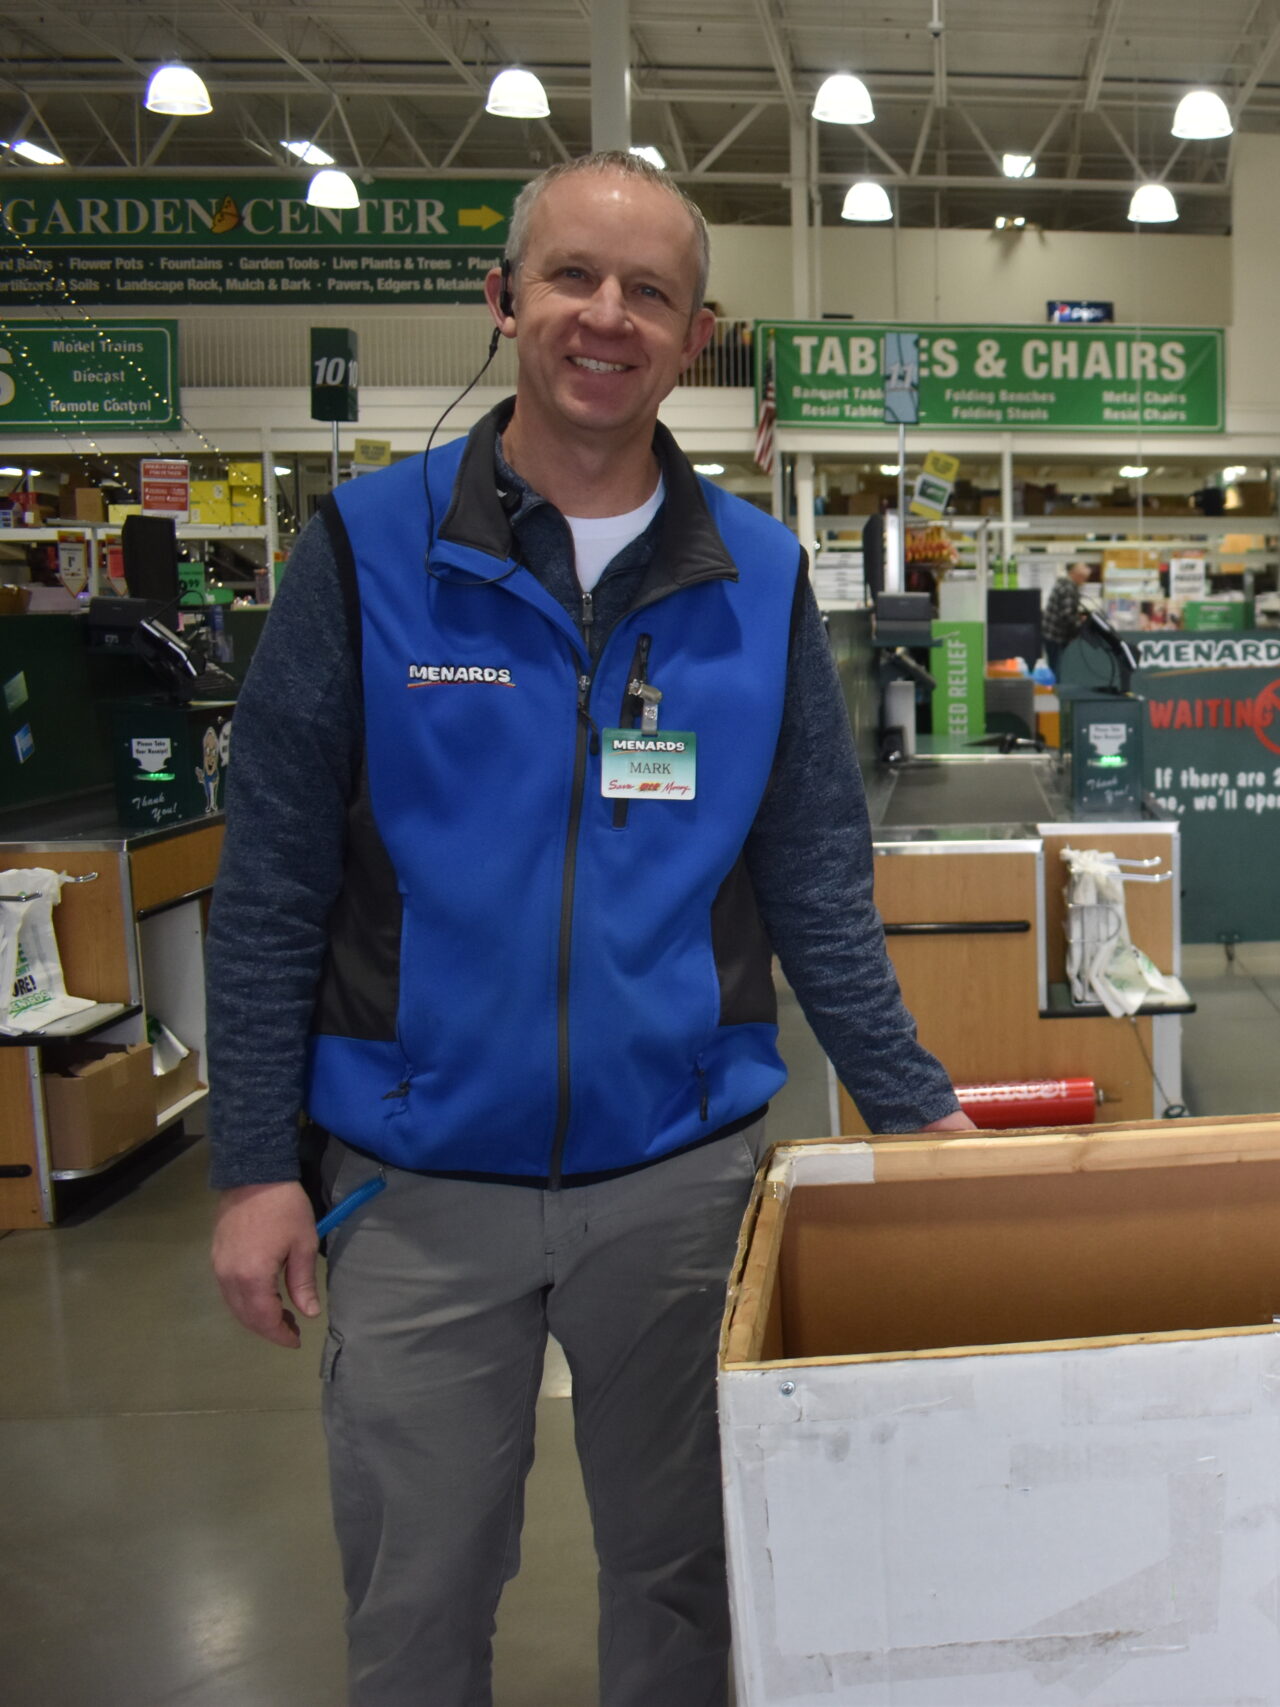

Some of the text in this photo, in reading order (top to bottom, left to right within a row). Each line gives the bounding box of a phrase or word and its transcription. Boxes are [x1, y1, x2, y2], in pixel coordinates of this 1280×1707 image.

[4, 199, 449, 235] GARDEN CENTER
[0, 257, 14, 270] rd
[69, 257, 144, 270] Flower Pots
[160, 257, 223, 270] Fountains
[240, 257, 320, 269] Garden Tools
[333, 257, 451, 269] Live Plants & Trees
[70, 279, 100, 291] Soils
[117, 279, 311, 293] Landscape Rock, Mulch & Bark
[328, 279, 374, 292] Pavers,
[377, 279, 420, 293] Edgers
[423, 279, 434, 291] &
[53, 341, 144, 353] Model Trains
[792, 336, 1186, 381] TABS & CHAIRS
[73, 370, 125, 383] Diecast
[314, 356, 346, 386] 10
[887, 362, 914, 389] 11
[792, 386, 885, 400] Banquet Tabl
[944, 389, 1056, 404] Folding Benches
[1102, 391, 1187, 404] Metal Chairs
[51, 400, 152, 413] Remote Control
[802, 404, 884, 417] Resin Table
[952, 407, 1049, 422] Folding Stools
[1102, 407, 1187, 421] Resin Chairs
[408, 664, 512, 684] MENARDS
[947, 640, 968, 735] EED RELIEF
[1149, 698, 1275, 729] WAITING
[613, 739, 685, 752] MENARDS
[629, 761, 672, 775] MARK
[1155, 768, 1172, 789] If
[1181, 767, 1229, 789] there
[1237, 770, 1267, 787] are
[131, 792, 166, 810] Thank
[1193, 788, 1238, 811] we'll
[151, 801, 178, 822] You!
